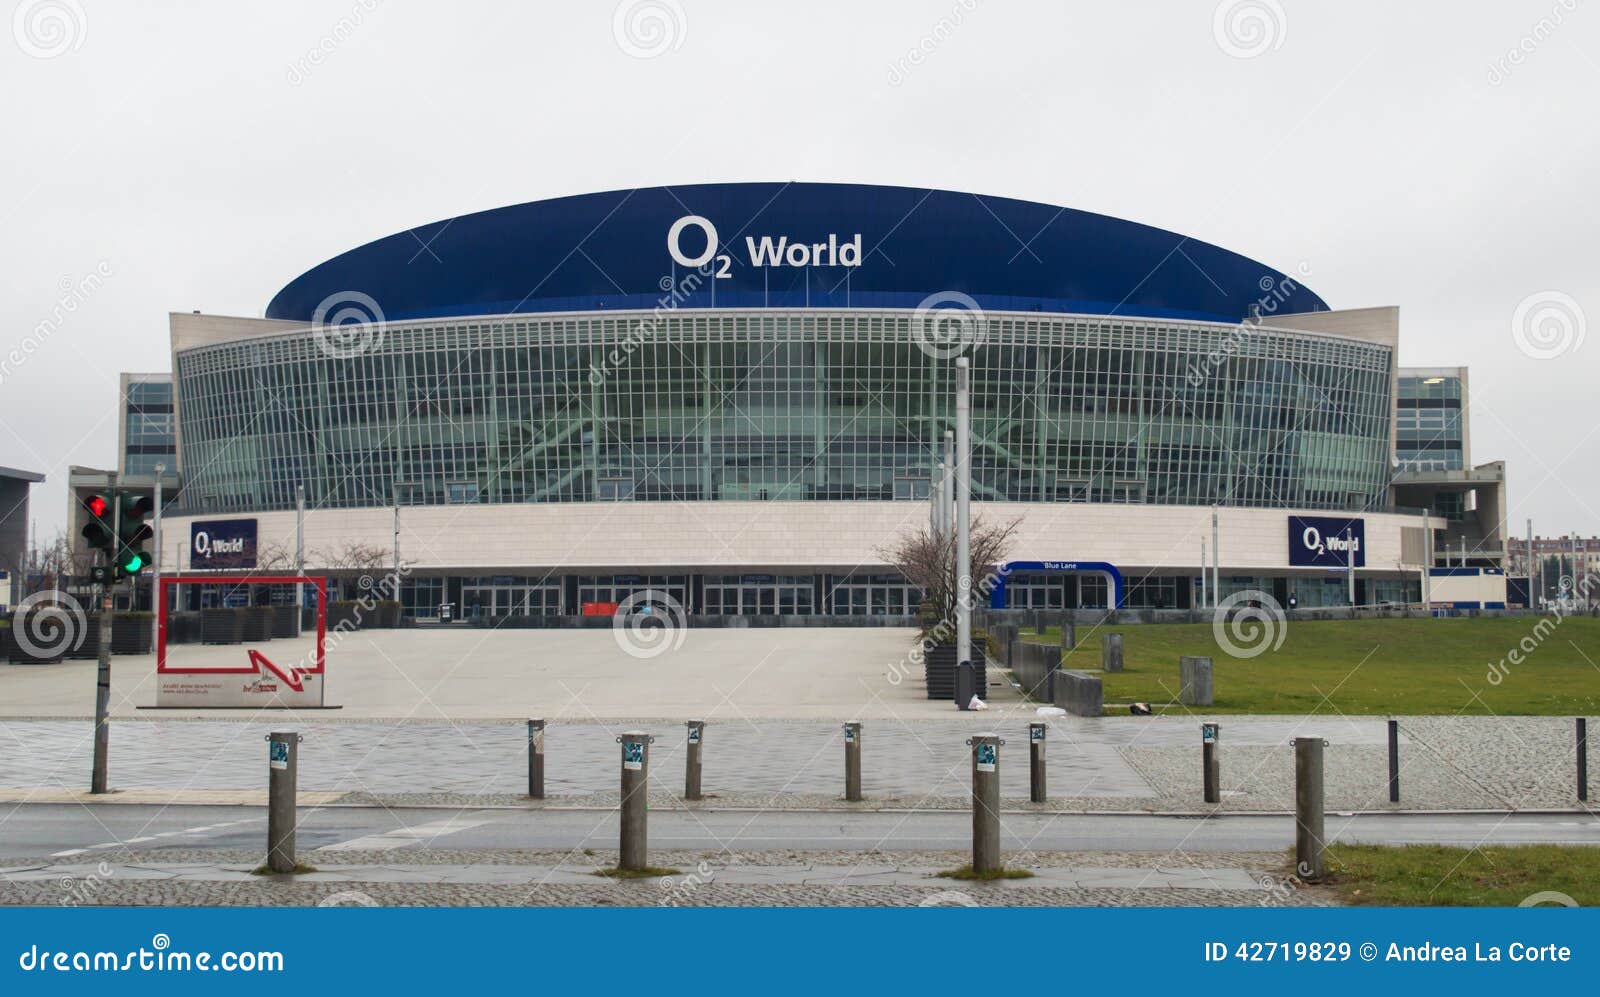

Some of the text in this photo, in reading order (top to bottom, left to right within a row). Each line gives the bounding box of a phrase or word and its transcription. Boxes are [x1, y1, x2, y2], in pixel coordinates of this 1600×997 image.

[745, 233, 862, 267] World
[212, 538, 243, 553] World
[1326, 536, 1359, 551] Word
